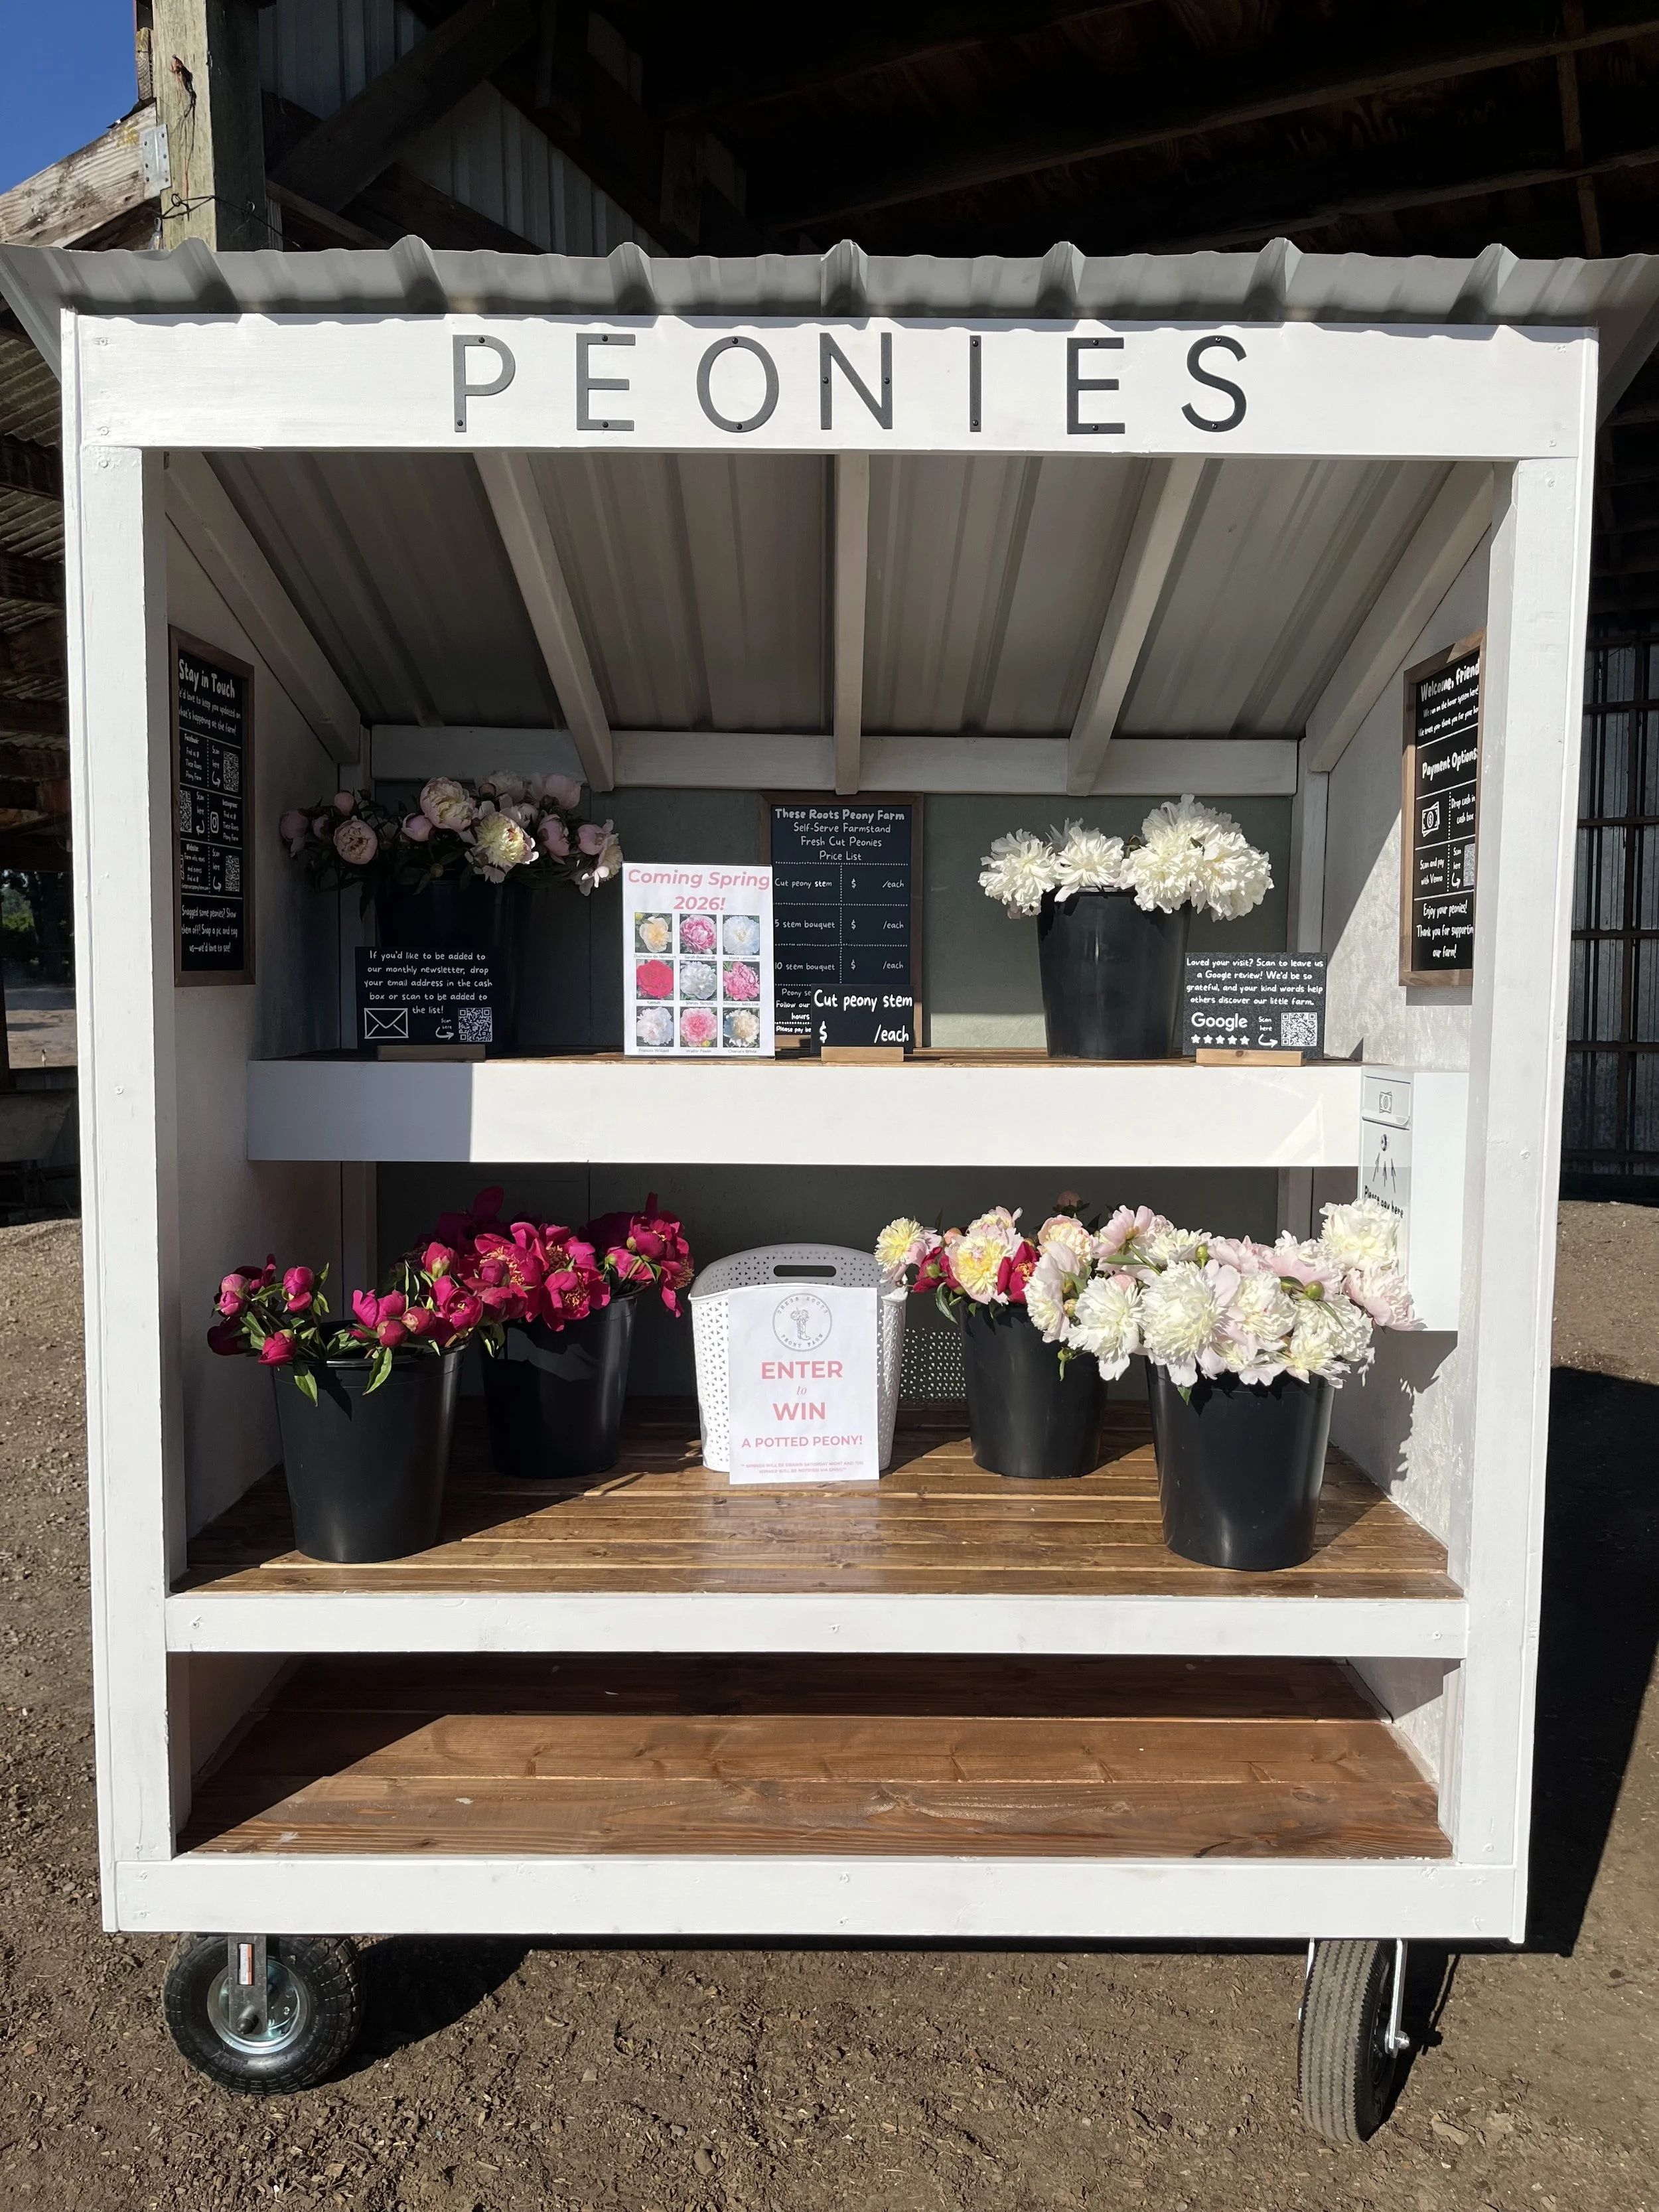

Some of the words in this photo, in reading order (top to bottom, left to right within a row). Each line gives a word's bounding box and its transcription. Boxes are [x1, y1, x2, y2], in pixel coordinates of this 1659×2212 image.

[453, 332, 1250, 435] PEONIES
[179, 658, 199, 692] Stay
[202, 670, 208, 688] in
[211, 673, 235, 698] Touch
[1421, 680, 1454, 702] Welcome,
[1422, 762, 1450, 781] Payment
[775, 808, 806, 818] These
[810, 809, 839, 820] Roots
[842, 809, 874, 824] Peony
[877, 810, 904, 820] Farm
[1457, 812, 1465, 824] cash
[794, 822, 839, 832] Self-Serve
[843, 823, 891, 833] Farmstand
[801, 836, 825, 846] Fresh
[829, 836, 845, 846] Cut
[849, 836, 882, 847] Peonies
[820, 850, 842, 860] Price
[846, 851, 861, 860] List
[1420, 859, 1429, 869] Scan
[628, 869, 703, 888] Coming
[708, 871, 770, 890] Spring
[774, 878, 788, 887] Cut
[851, 878, 856, 889] $
[883, 879, 904, 888] /each
[1430, 873, 1443, 883] Venmo
[674, 896, 726, 911] 2026!
[1423, 903, 1435, 919] Enjoy
[1437, 906, 1447, 919] your
[1449, 900, 1467, 917] peonies!
[804, 921, 835, 930] bouquet
[851, 920, 856, 930] $
[883, 921, 904, 929] /each
[1417, 924, 1431, 937] Thank
[1451, 924, 1474, 938] supportin
[382, 951, 402, 961] you'd
[1433, 949, 1441, 958] our
[1443, 944, 1457, 958] farm!
[806, 963, 835, 972] bouquet
[851, 960, 855, 970] $
[883, 961, 903, 970] /each
[1232, 958, 1254, 967] visit?
[386, 965, 417, 975] monthly
[470, 966, 488, 975] drop
[1205, 970, 1231, 980] Google
[1234, 971, 1262, 980] review!
[1266, 970, 1287, 980] We'd
[782, 988, 802, 997] Peony
[1187, 984, 1219, 992] grateful,
[1308, 985, 1323, 994] help
[814, 990, 837, 1007] Cut
[843, 995, 877, 1012] peony
[883, 994, 912, 1007] stem
[1191, 1012, 1248, 1031] Google
[820, 1021, 827, 1043] $
[874, 1024, 908, 1043] /each
[762, 1361, 843, 1379] ENTER
[796, 1386, 807, 1395] to
[772, 1402, 826, 1420] WIN
[741, 1438, 751, 1447] A
[756, 1438, 808, 1447] POTTED
[814, 1436, 862, 1445] PEONY!
